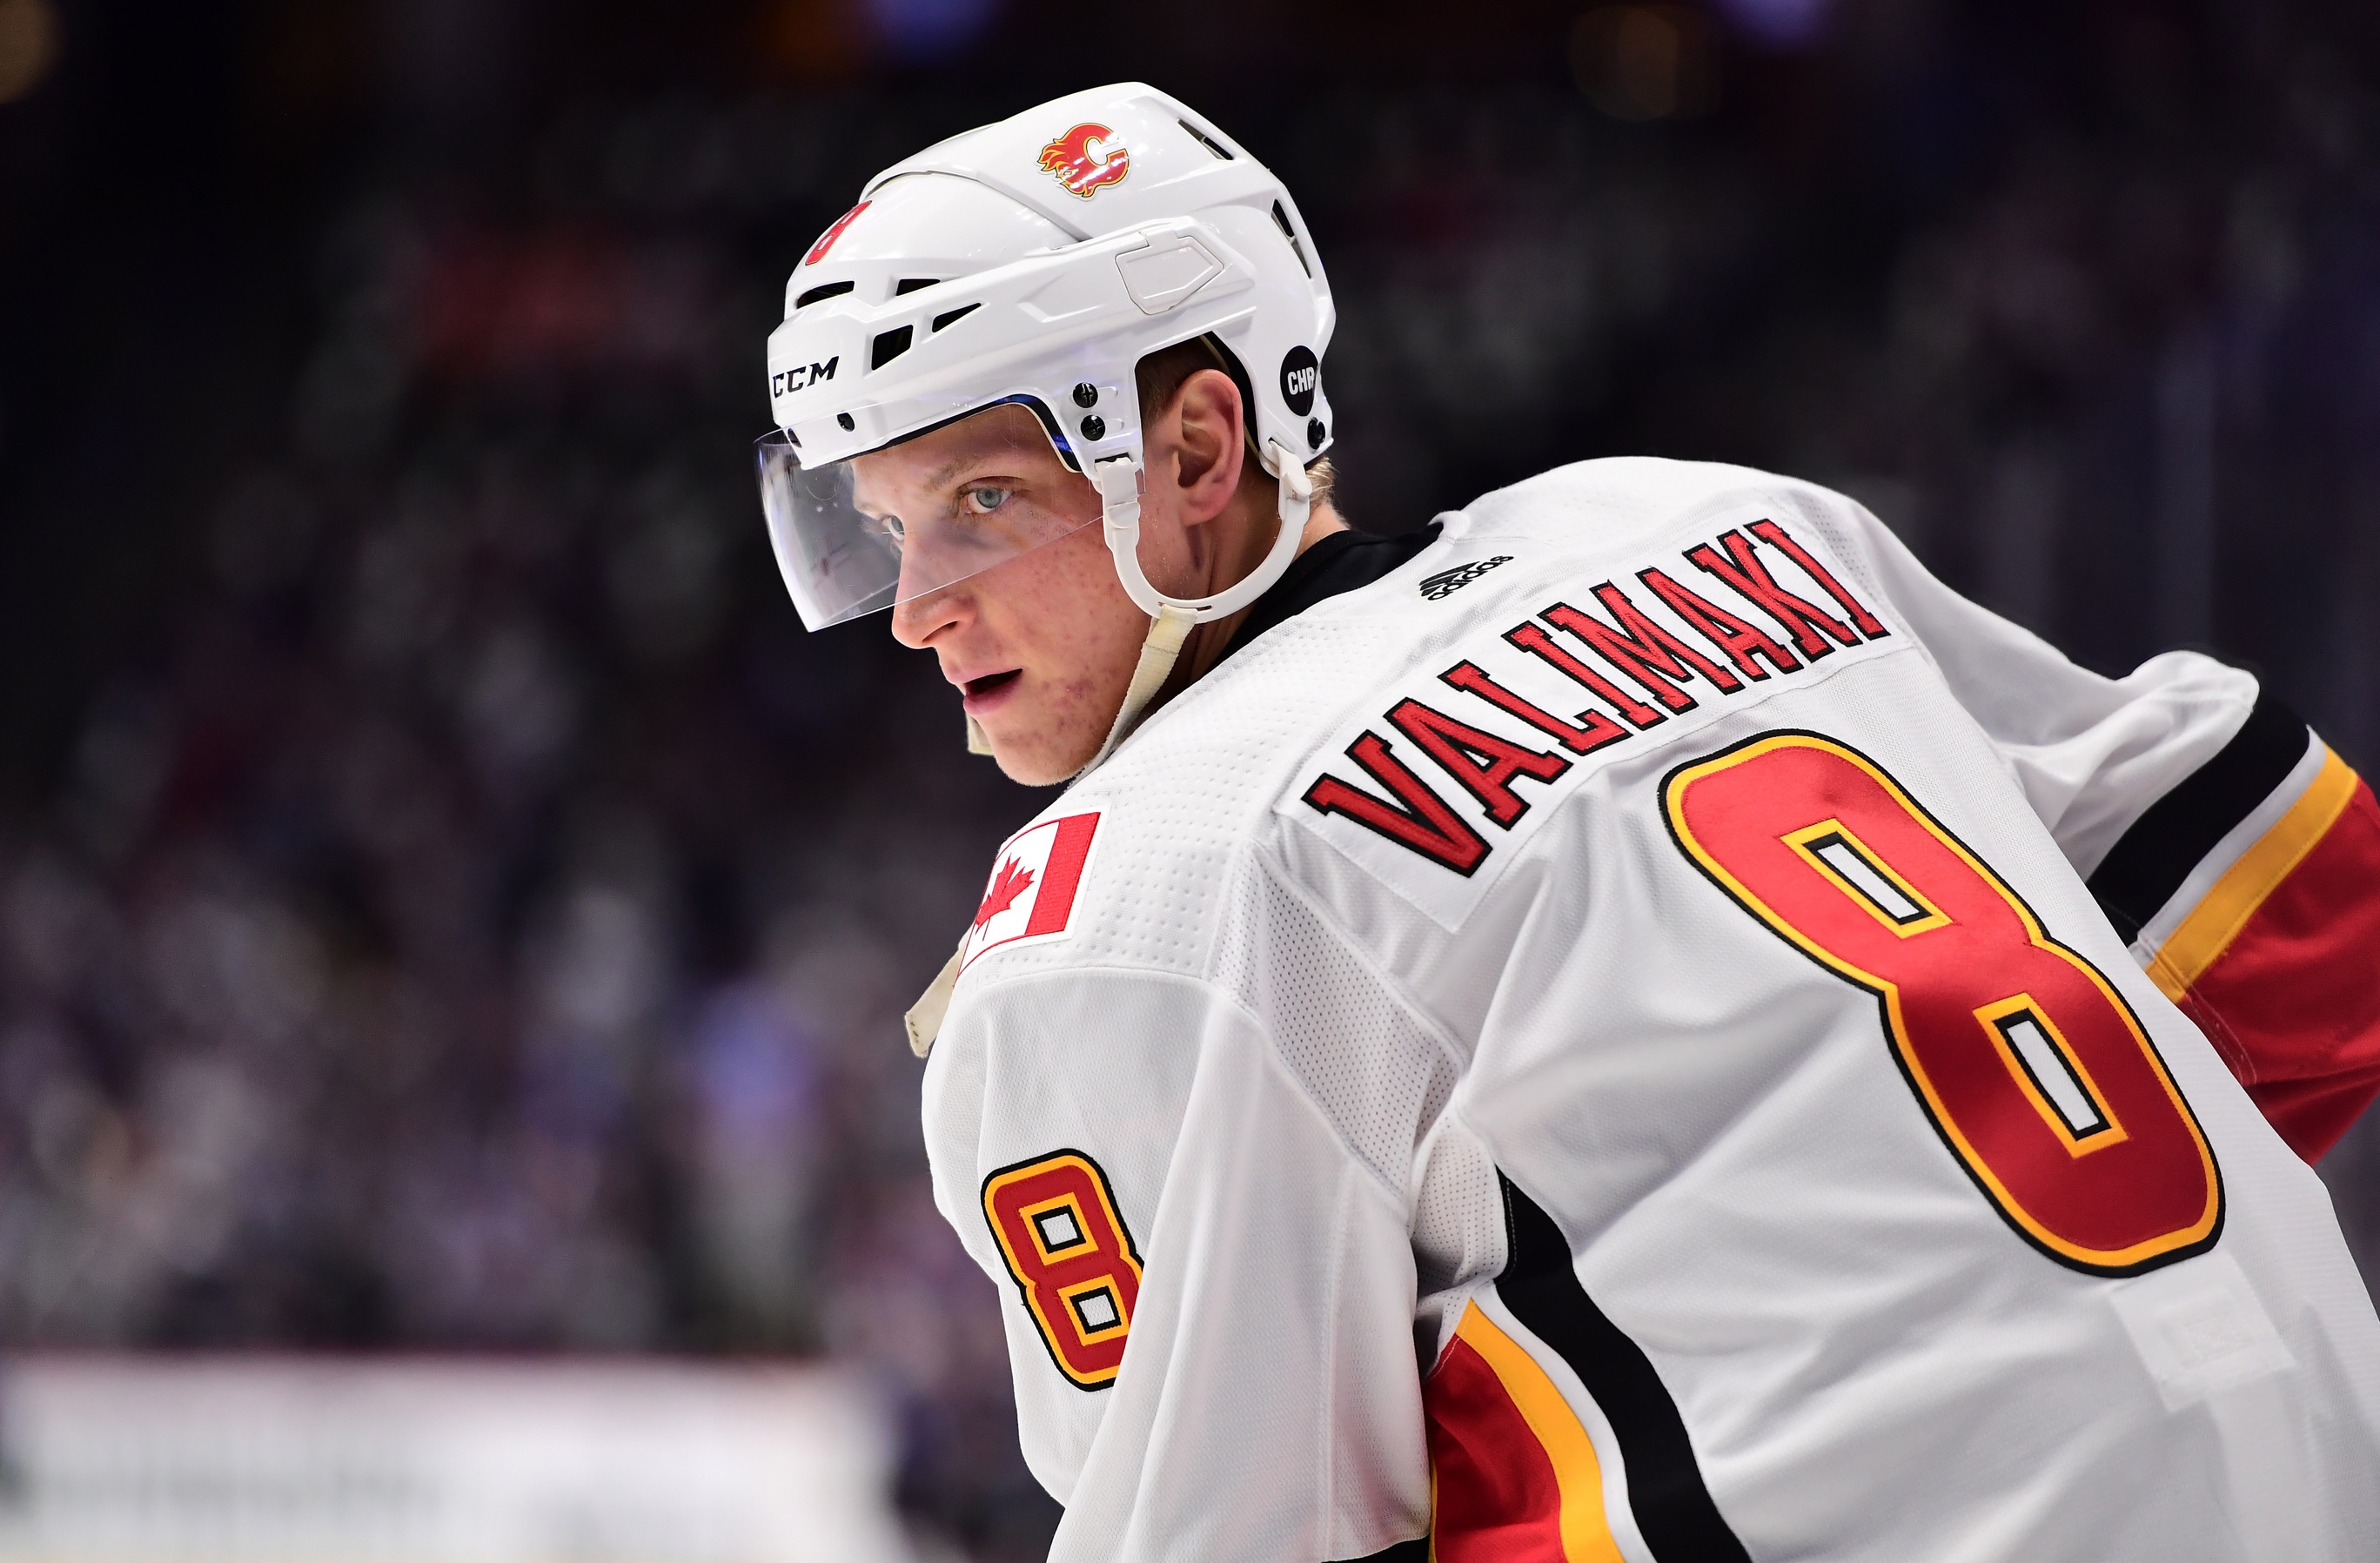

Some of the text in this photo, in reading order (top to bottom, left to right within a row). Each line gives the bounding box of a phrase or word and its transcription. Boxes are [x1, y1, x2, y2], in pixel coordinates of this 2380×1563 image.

[805, 200, 873, 265] 8
[772, 355, 840, 399] CCM
[1427, 555, 1514, 600] adidas
[1302, 518, 1890, 879] VALIMAKI
[1659, 728, 2226, 1278] 8
[980, 1148, 1144, 1392] 8
